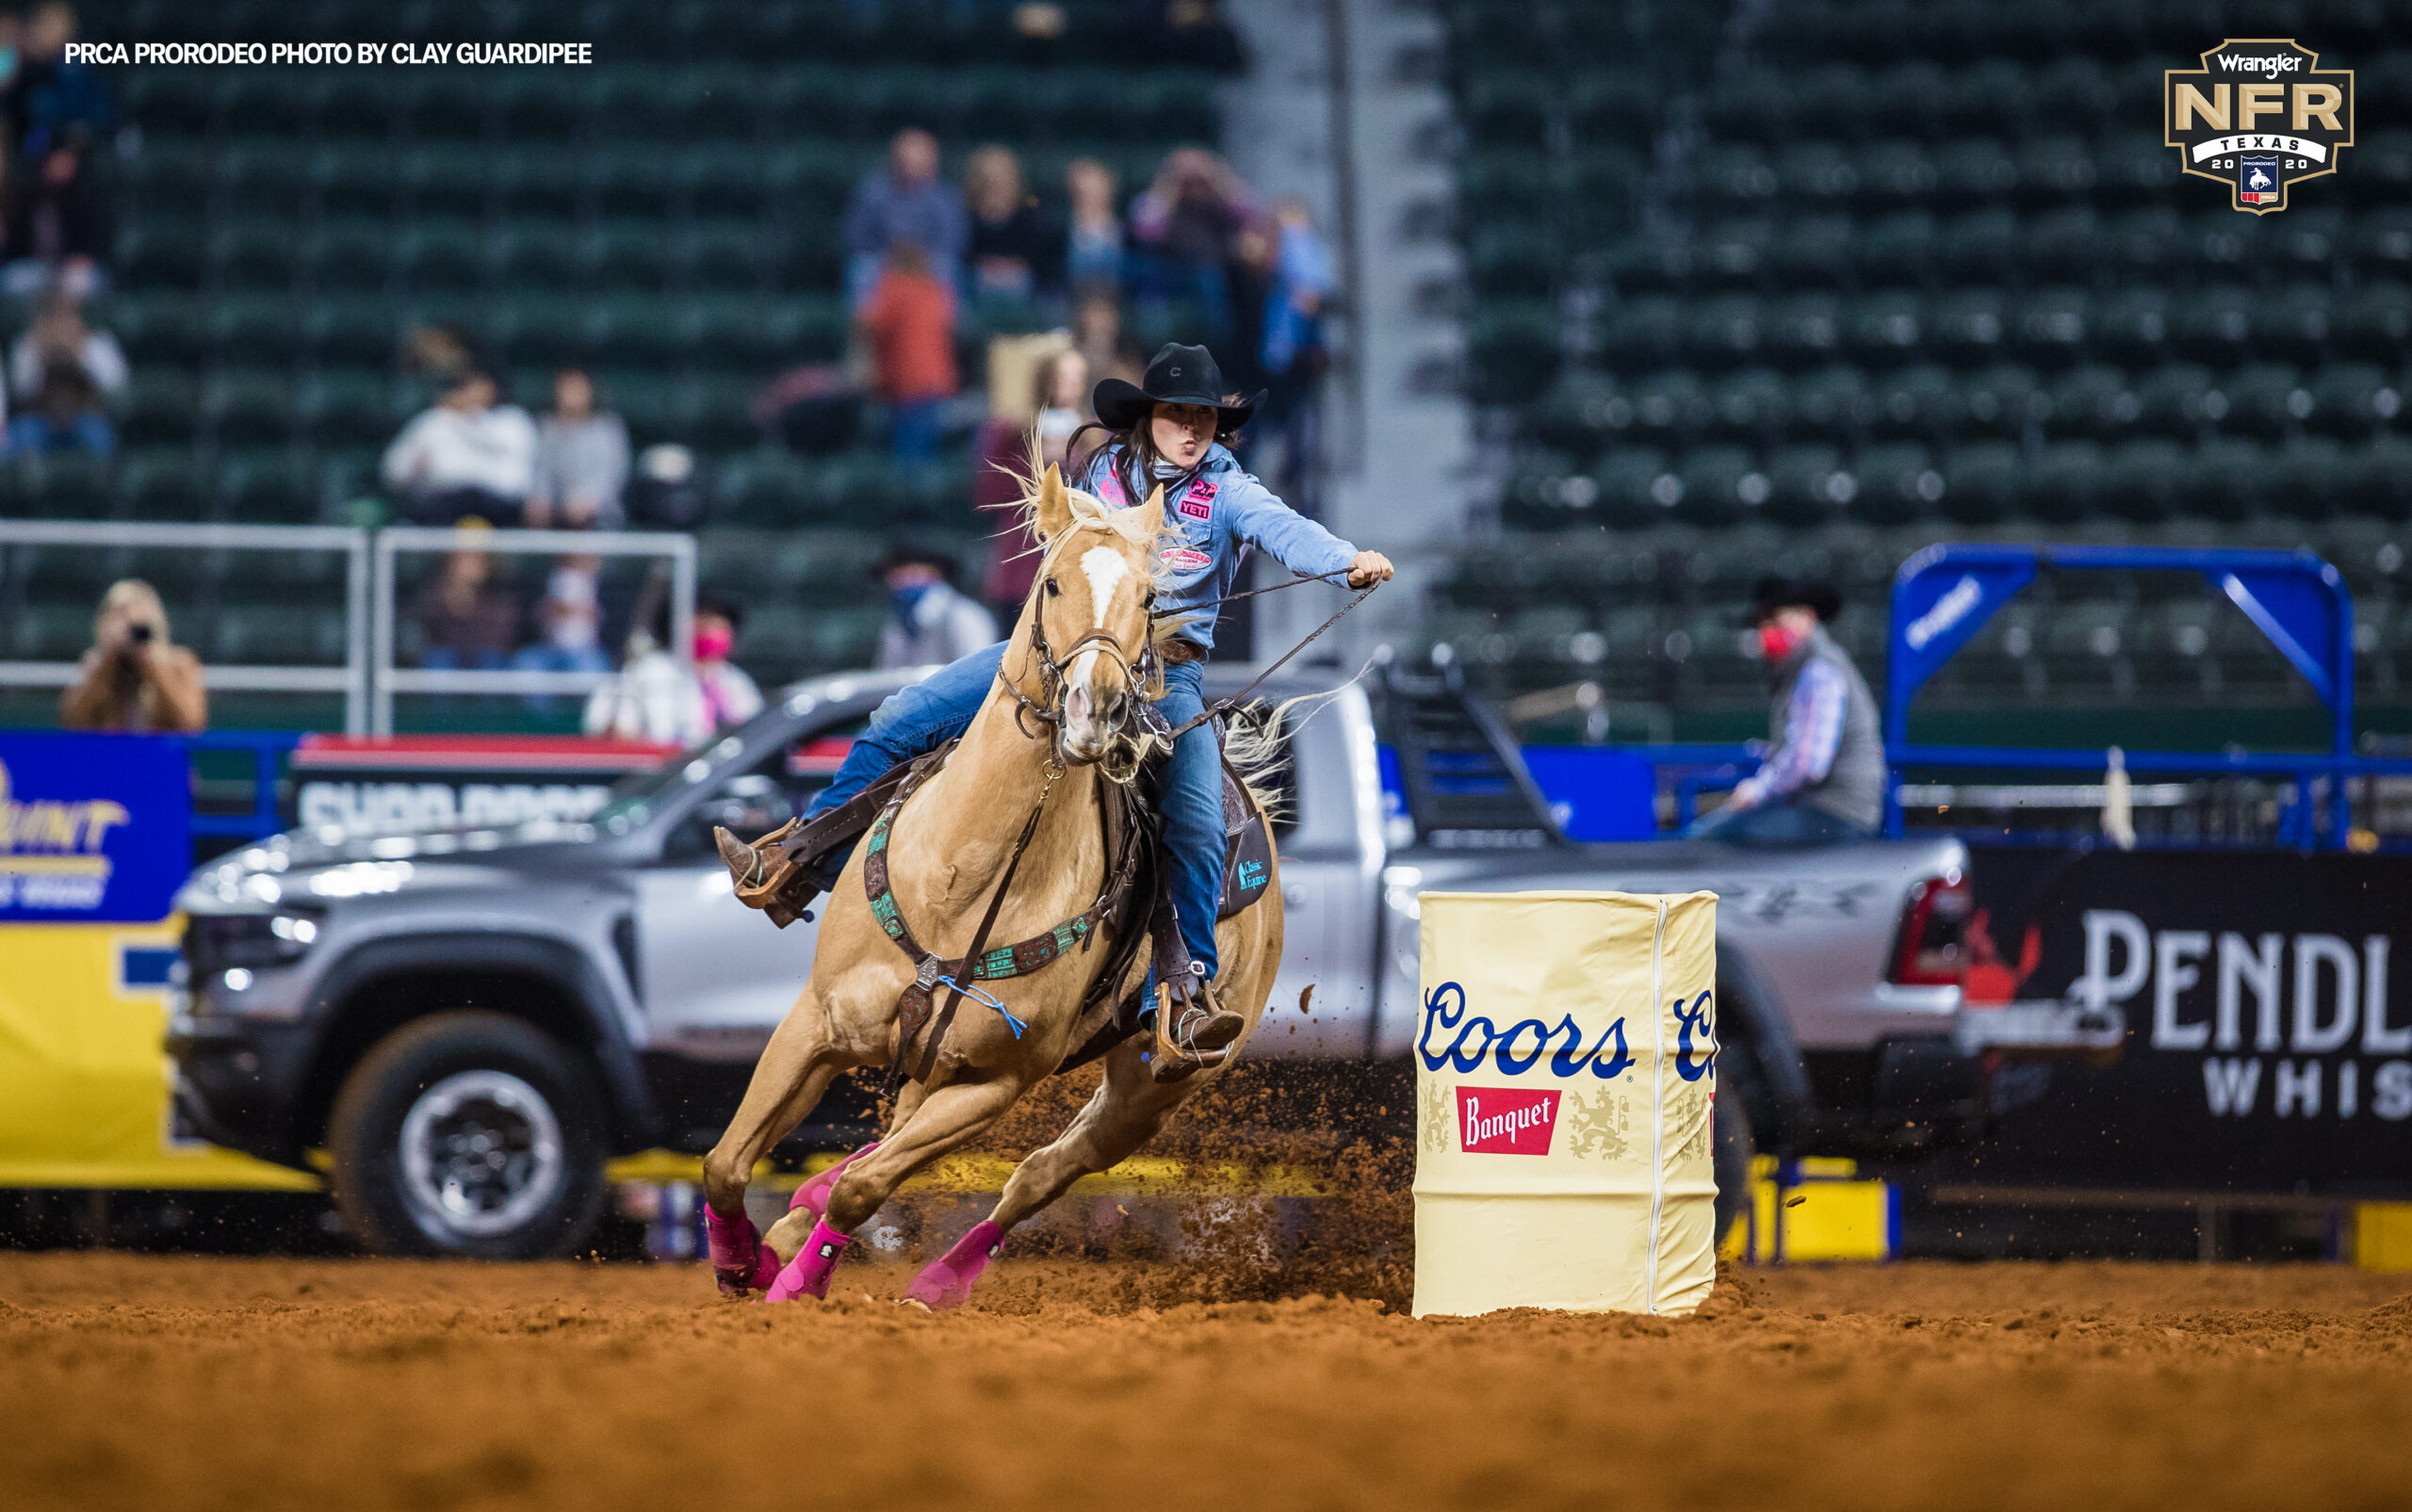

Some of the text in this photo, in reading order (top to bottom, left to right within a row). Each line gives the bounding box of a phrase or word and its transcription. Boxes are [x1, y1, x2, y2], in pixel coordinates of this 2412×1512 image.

[1182, 501, 1209, 518] YETI
[1245, 858, 1263, 874] Classic
[1247, 874, 1267, 890] Equine
[2065, 908, 2412, 1055] PENDL
[1419, 981, 1637, 1080] Coors
[2201, 1056, 2412, 1121] WHIS
[1465, 1095, 1552, 1147] Banquet
